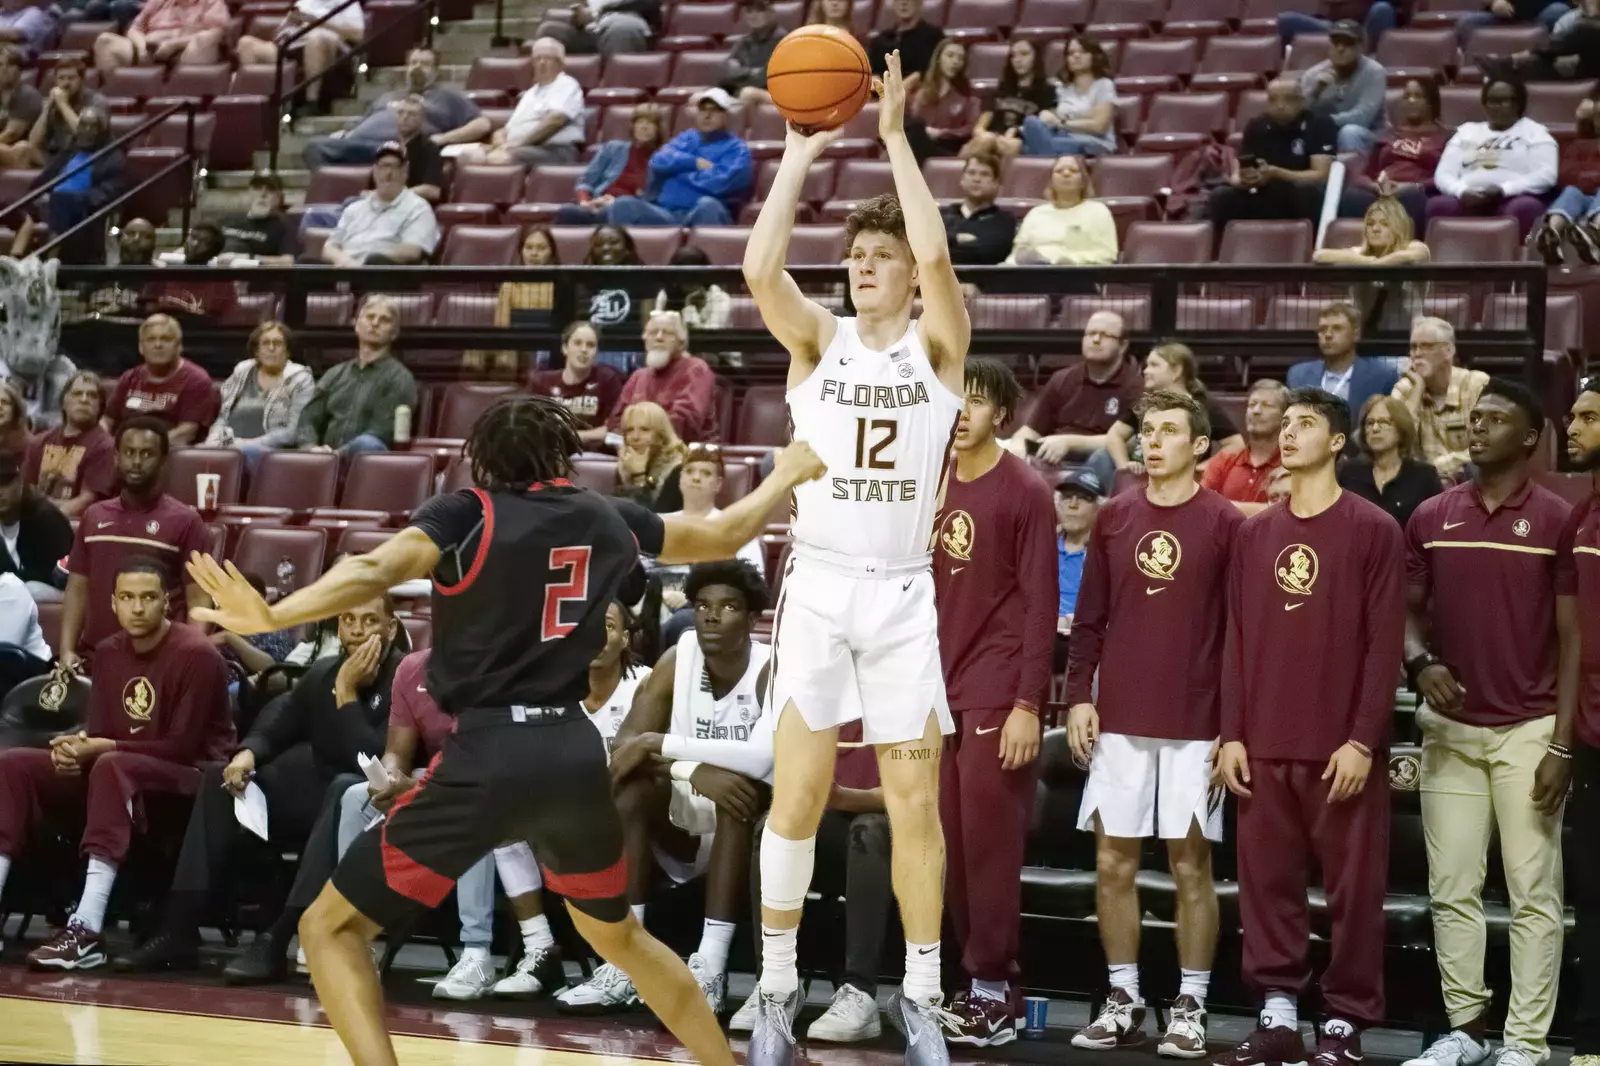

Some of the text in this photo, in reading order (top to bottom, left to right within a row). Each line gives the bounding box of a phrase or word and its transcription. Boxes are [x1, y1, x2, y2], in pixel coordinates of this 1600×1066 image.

[820, 379, 930, 408] FLORIDA
[855, 417, 898, 470] 12
[832, 477, 917, 502] STATE
[541, 545, 592, 642] 2
[696, 717, 712, 740] CLE
